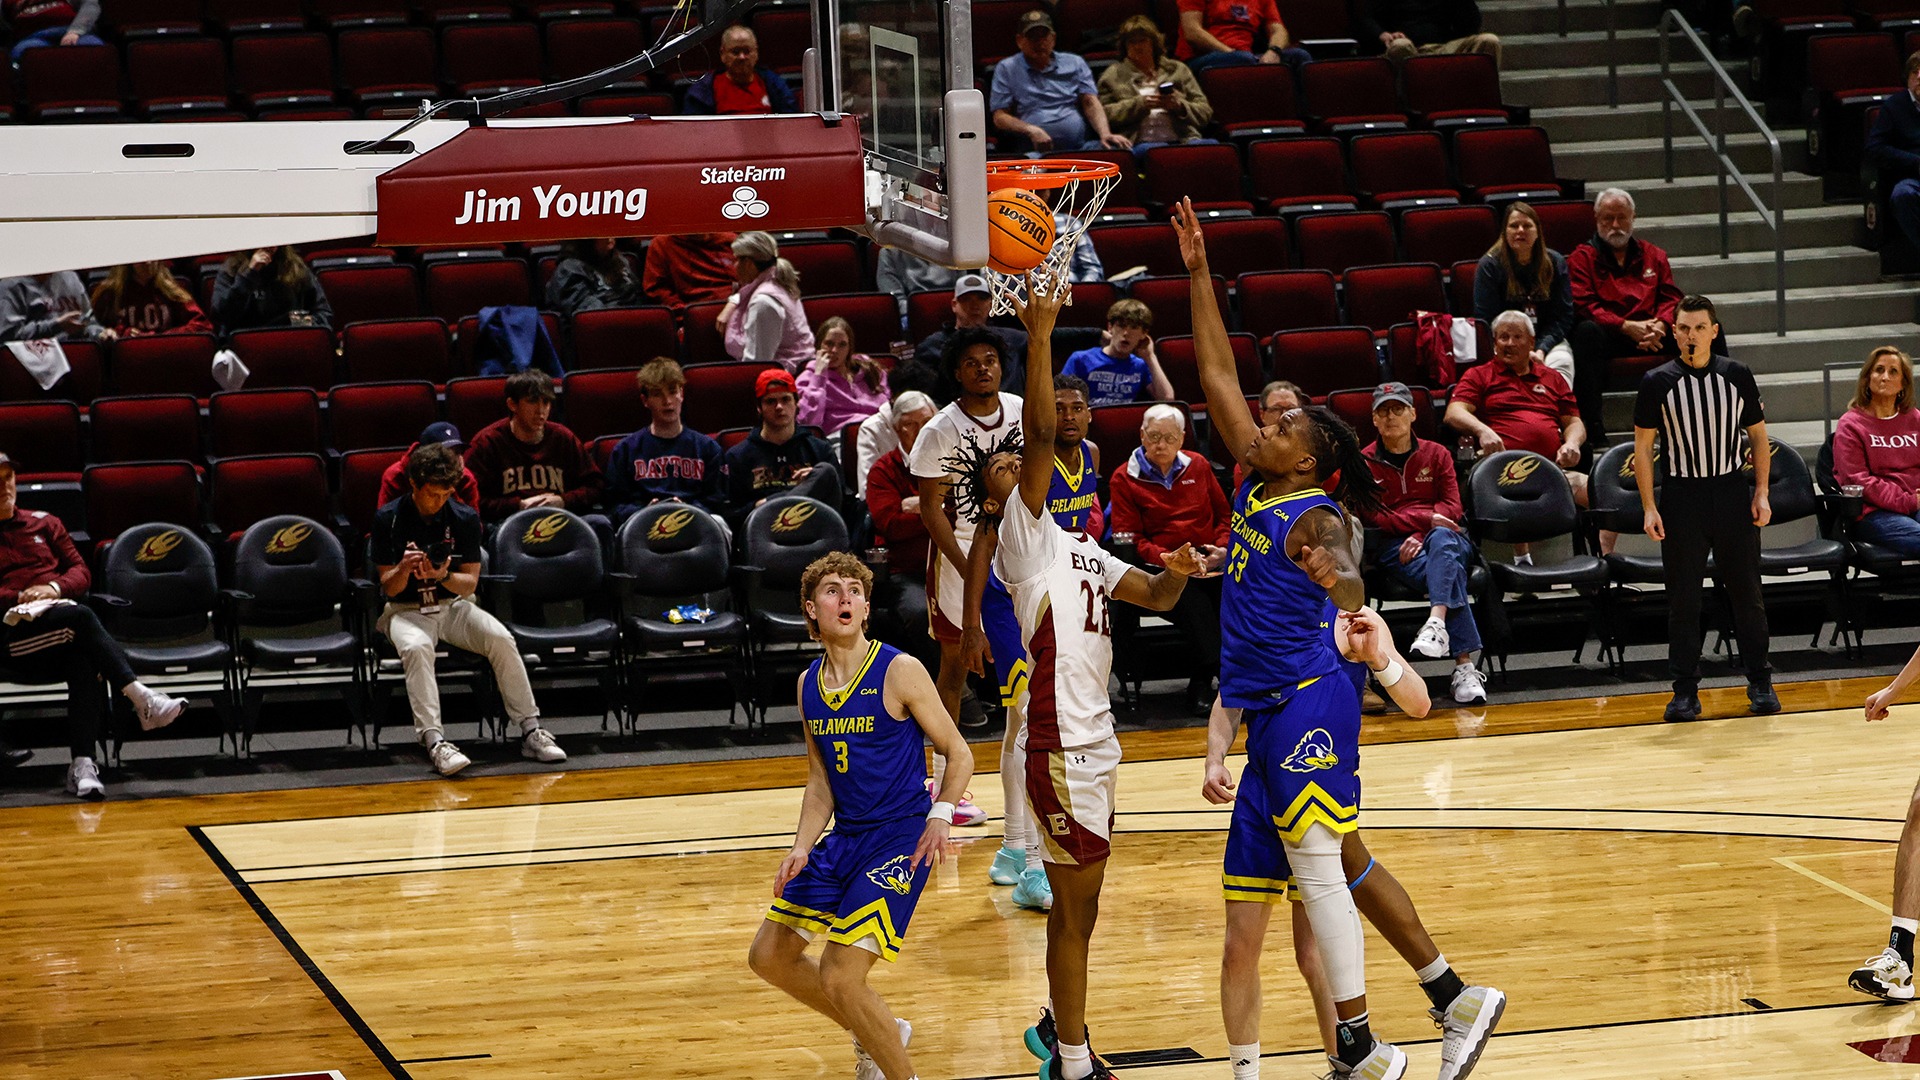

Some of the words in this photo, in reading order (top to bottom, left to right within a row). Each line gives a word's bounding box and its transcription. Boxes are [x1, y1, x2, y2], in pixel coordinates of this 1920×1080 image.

[455, 188, 521, 225] Jim
[532, 184, 648, 221] Young
[1015, 191, 1051, 218] NCAA
[998, 204, 1047, 246] Wilson
[1869, 433, 1918, 448] ELON
[502, 464, 564, 494] ELON
[634, 455, 704, 481] DAYTON
[1050, 492, 1095, 514] DELAWARE
[1273, 508, 1290, 523] CAA
[1071, 515, 1079, 527] 1
[1230, 510, 1272, 556] ELAWARE
[1227, 541, 1250, 584] 13
[860, 687, 878, 696] CAA
[832, 740, 849, 774] 3
[1046, 812, 1071, 836] E
